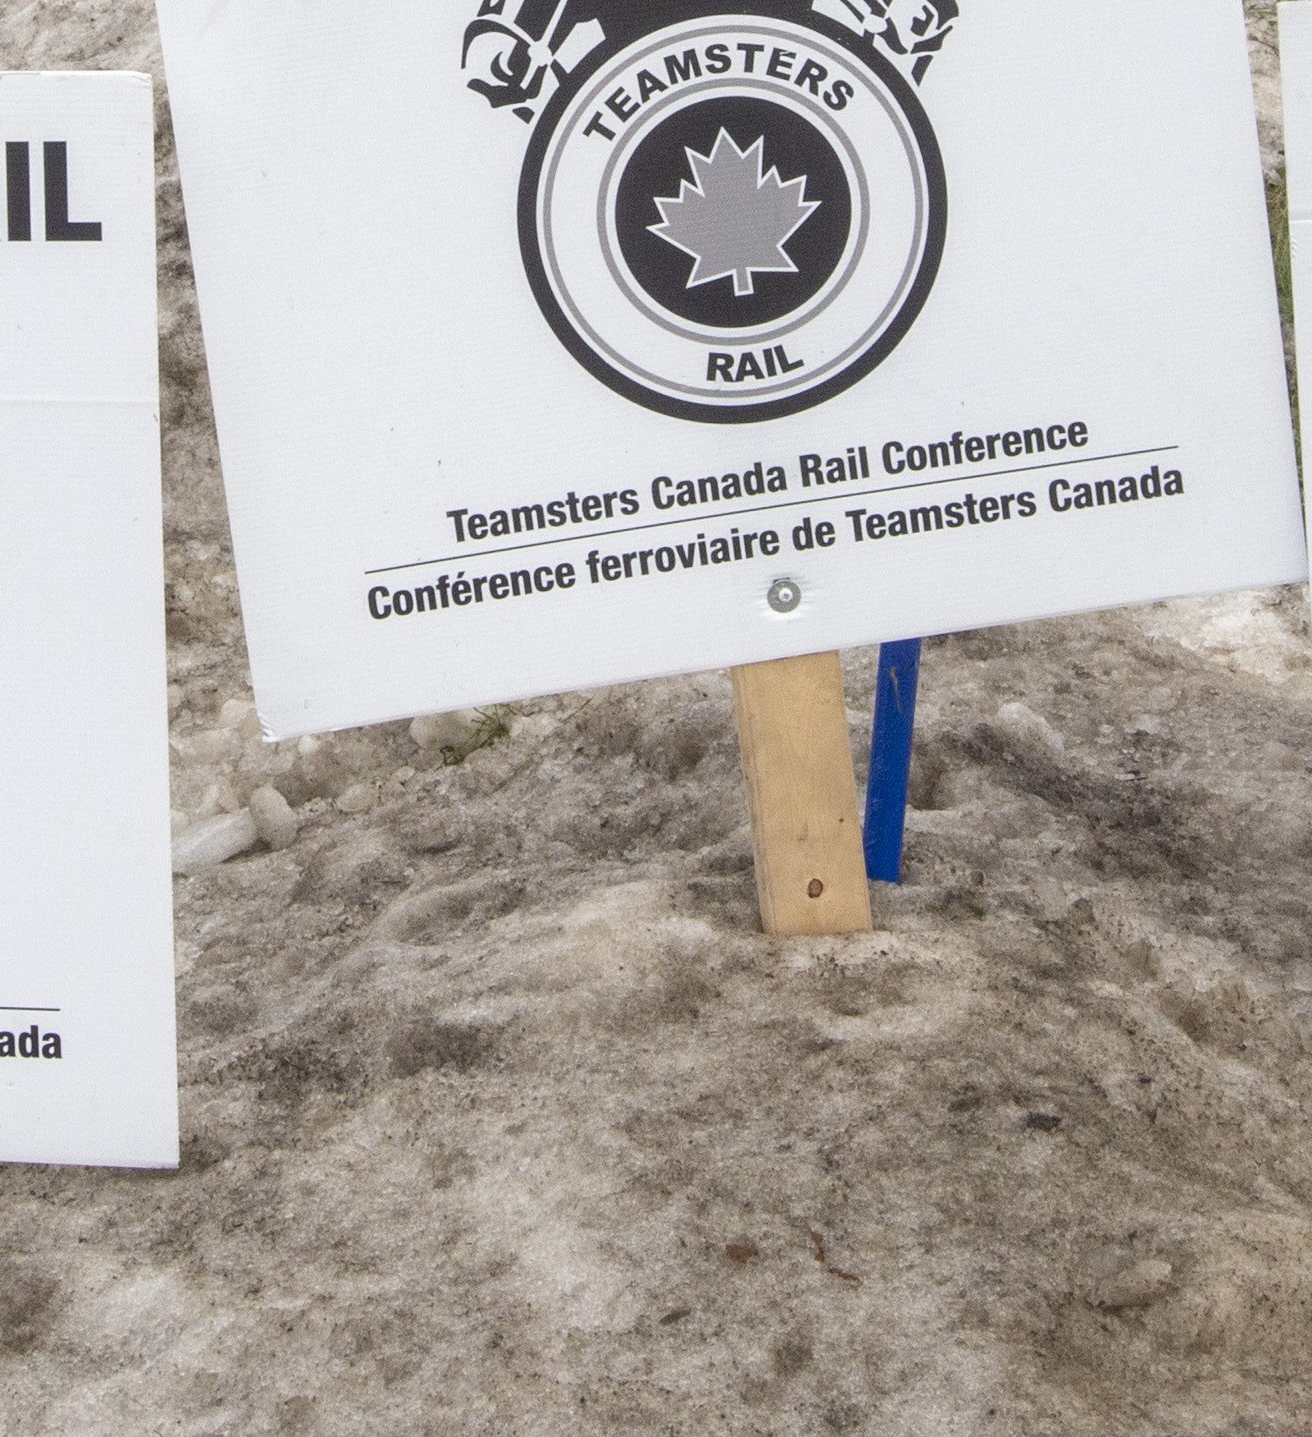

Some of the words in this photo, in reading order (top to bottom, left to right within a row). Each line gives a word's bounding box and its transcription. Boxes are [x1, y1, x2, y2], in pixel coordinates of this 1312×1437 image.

[583, 43, 853, 140] TEAMSTERS
[707, 345, 804, 382] RAIL
[447, 490, 639, 542] Teamsters
[652, 463, 787, 509] Canada
[800, 447, 869, 487] Rail
[882, 422, 1087, 474] Conference
[368, 563, 575, 619] Conférence
[586, 528, 779, 583] ferroviaire
[793, 517, 835, 550] de
[845, 492, 1036, 541] Teamsters
[1049, 466, 1183, 511] Canada
